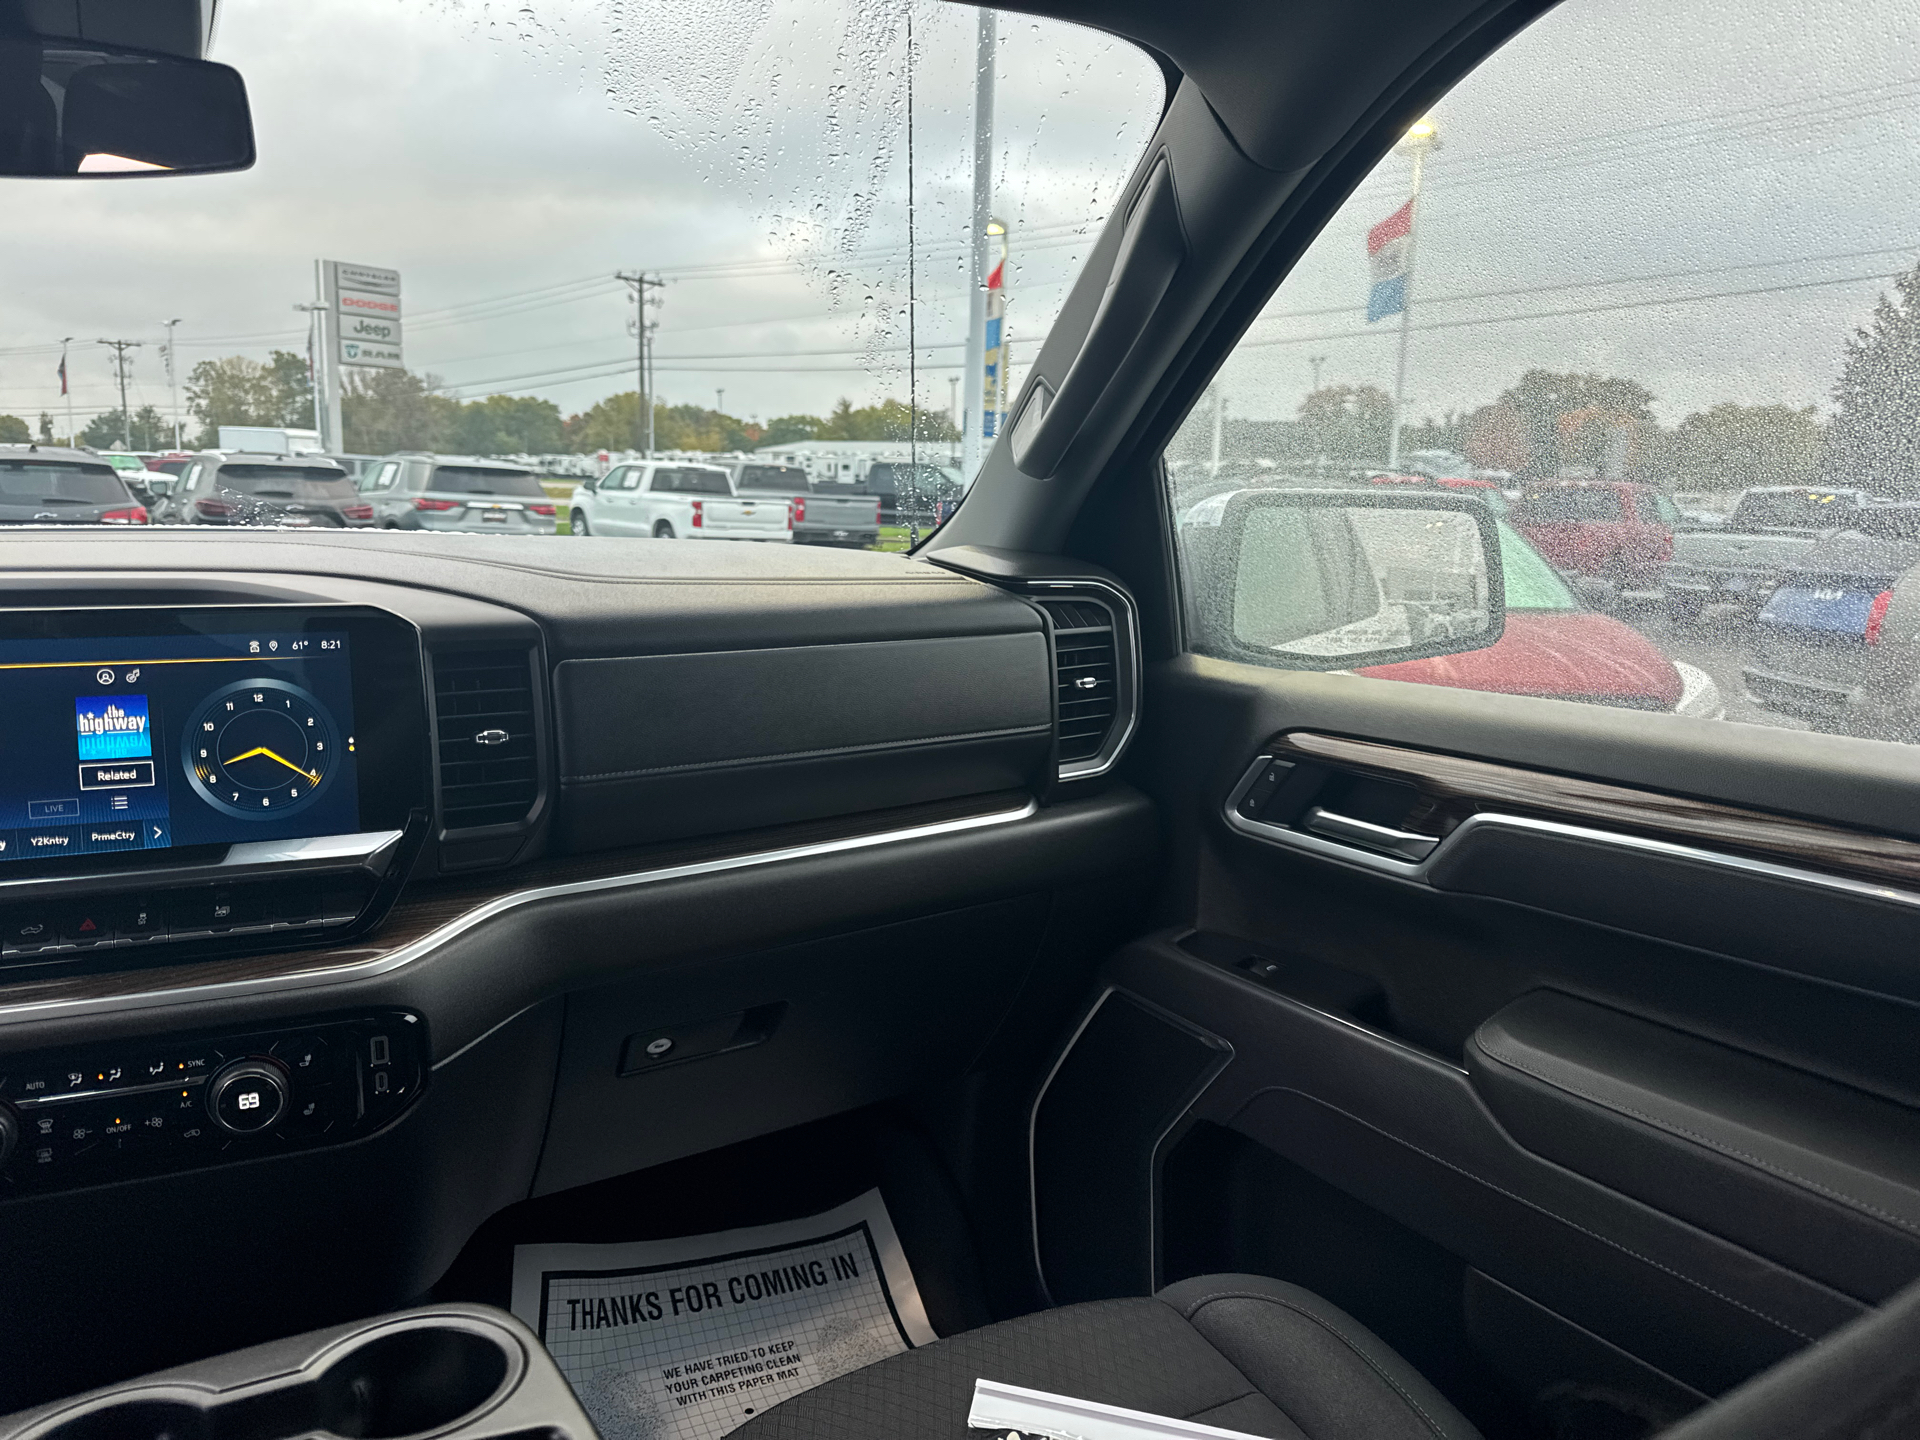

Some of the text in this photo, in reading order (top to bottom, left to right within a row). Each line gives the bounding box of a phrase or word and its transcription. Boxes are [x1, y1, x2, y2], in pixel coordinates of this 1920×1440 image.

[353, 319, 391, 339] Jeep
[321, 640, 341, 649] 8:21
[253, 693, 264, 703] 12
[226, 701, 234, 711] 11
[286, 700, 290, 708] 1
[107, 704, 125, 718] the
[79, 711, 146, 735] highway
[203, 722, 214, 731] 10
[307, 717, 314, 726] 2
[316, 741, 323, 750] 3
[200, 749, 207, 758] 9
[97, 768, 137, 781] Related
[209, 774, 217, 783] 8
[233, 792, 239, 801] 7
[291, 788, 298, 797] 5
[263, 797, 270, 806] 6
[44, 804, 64, 813] LIVE
[91, 830, 135, 842] PrmeCtry
[30, 836, 69, 847] Y2Kntry
[187, 1059, 206, 1069] SYNC
[25, 1081, 45, 1091] AUTO
[180, 1100, 193, 1109] A/C
[238, 1092, 260, 1110] 69
[106, 1123, 132, 1134] ON/OFF
[567, 1252, 859, 1331] THANKS FOR COMING IN
[663, 1340, 795, 1380] WE HAVE TRIED TO KEEP
[665, 1353, 801, 1394] YOUR CARPETING CLEAN
[676, 1367, 800, 1406] WITH THIS PAPER MAT
